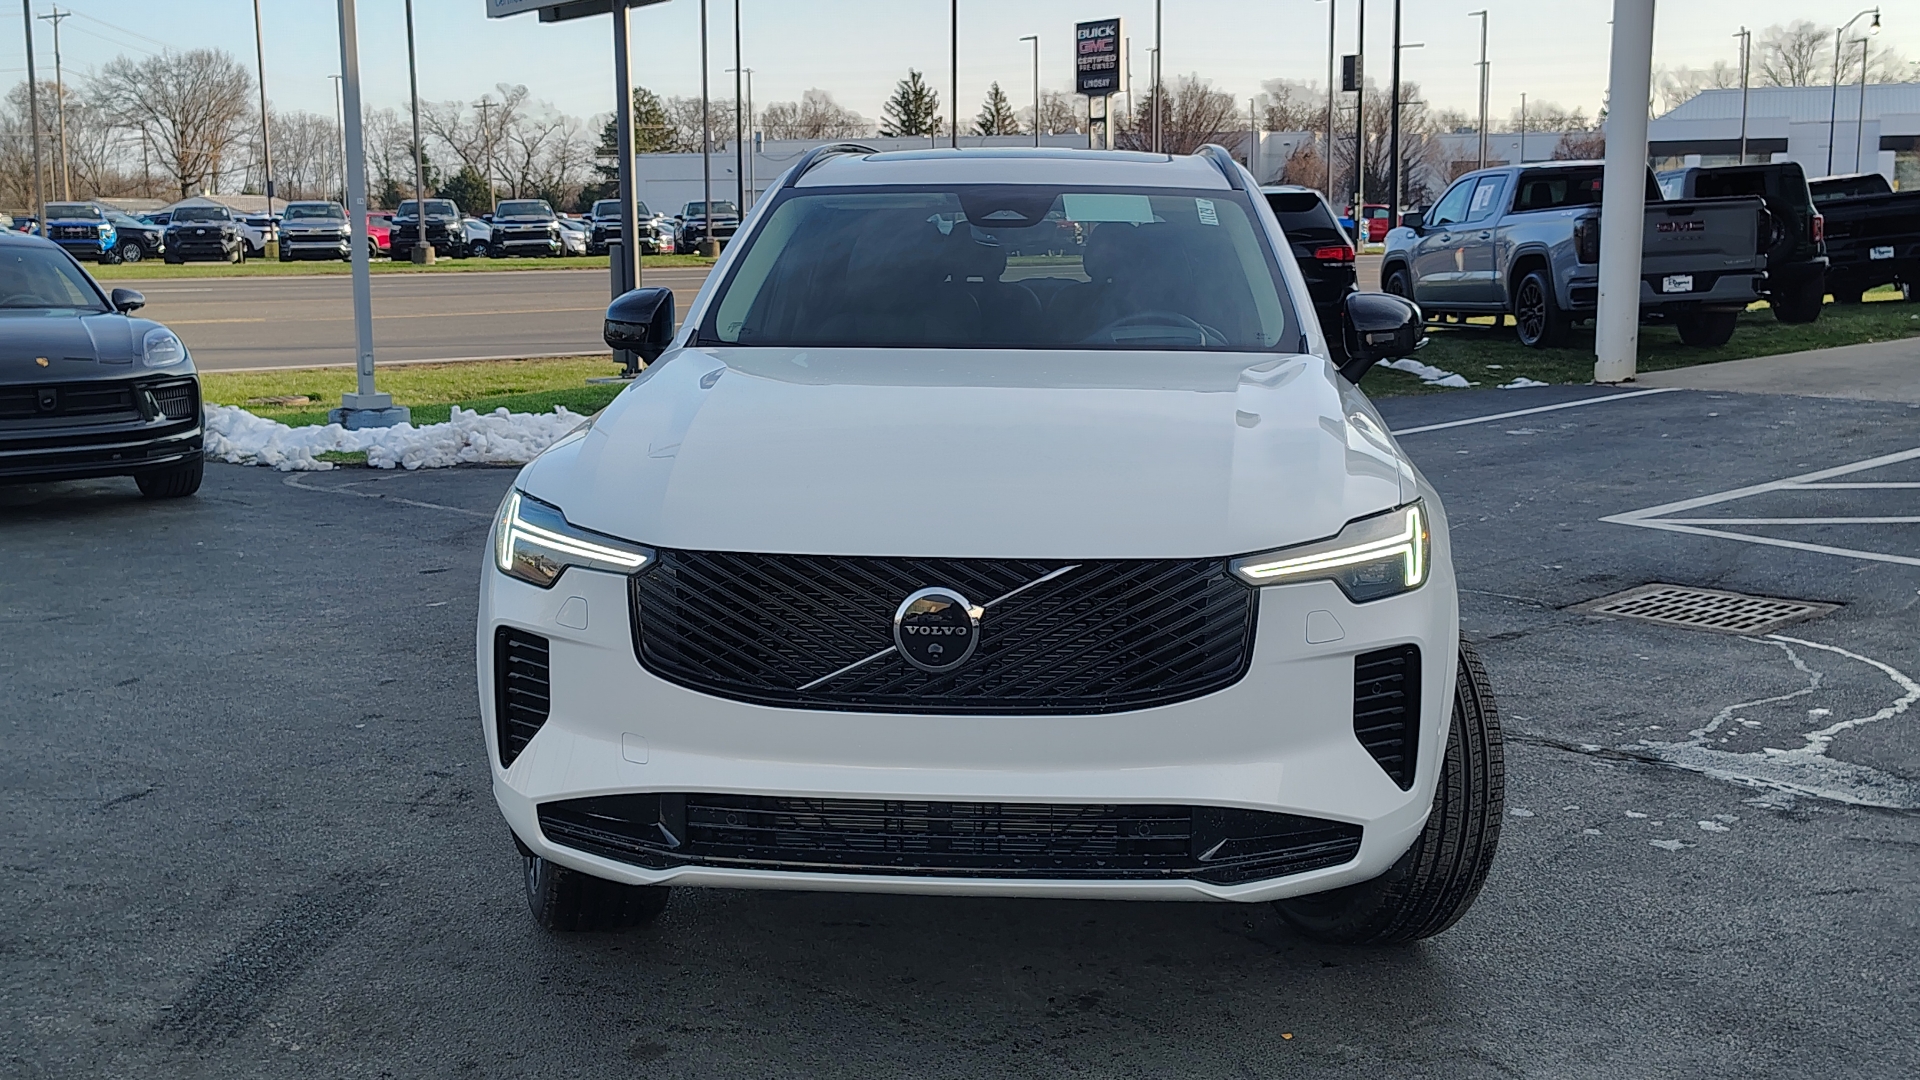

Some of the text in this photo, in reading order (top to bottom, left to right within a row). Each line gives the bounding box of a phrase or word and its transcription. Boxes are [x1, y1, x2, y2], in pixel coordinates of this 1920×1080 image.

[1078, 26, 1115, 39] BUICK
[1079, 39, 1114, 54] GMC
[1078, 55, 1117, 65] CERTIFIED
[1079, 62, 1115, 71] PRE-OWNED
[1083, 78, 1110, 88] LINDSAY
[904, 625, 967, 635] VOLVO
